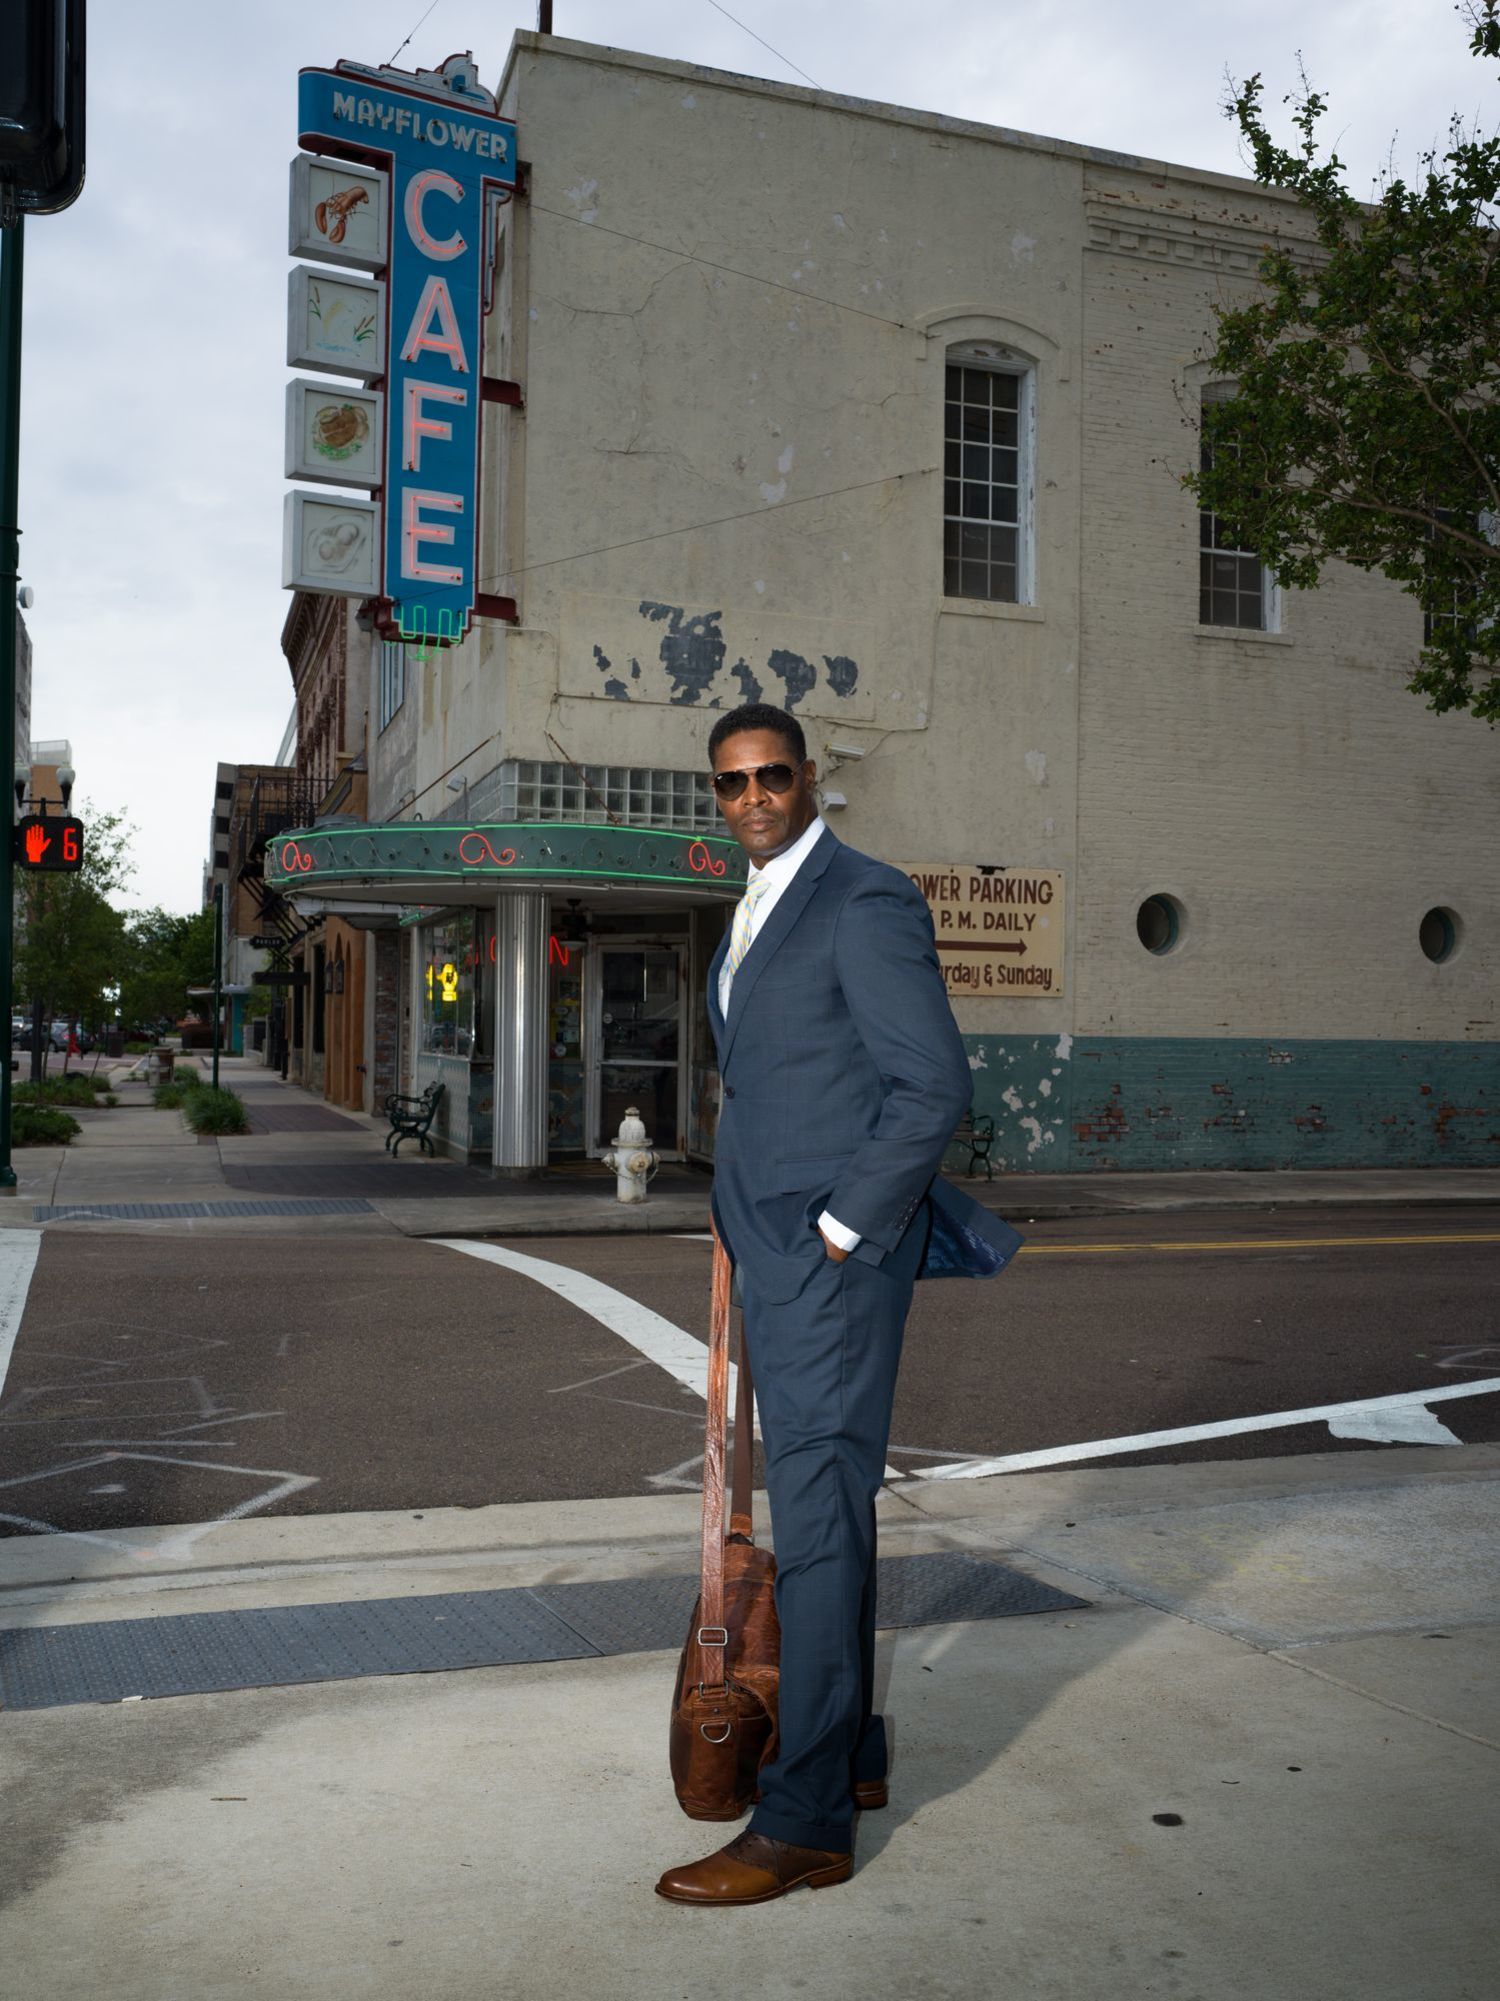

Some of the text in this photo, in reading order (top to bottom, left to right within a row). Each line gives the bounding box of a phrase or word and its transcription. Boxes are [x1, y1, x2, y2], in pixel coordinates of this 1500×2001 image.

[333, 91, 508, 162] MAYFLOWER
[399, 168, 470, 586] CAFE
[63, 827, 78, 861] 6
[969, 876, 1054, 905] PARKING
[983, 911, 1036, 932] DAILY
[984, 963, 993, 988] &
[997, 964, 1053, 991] Sunday
